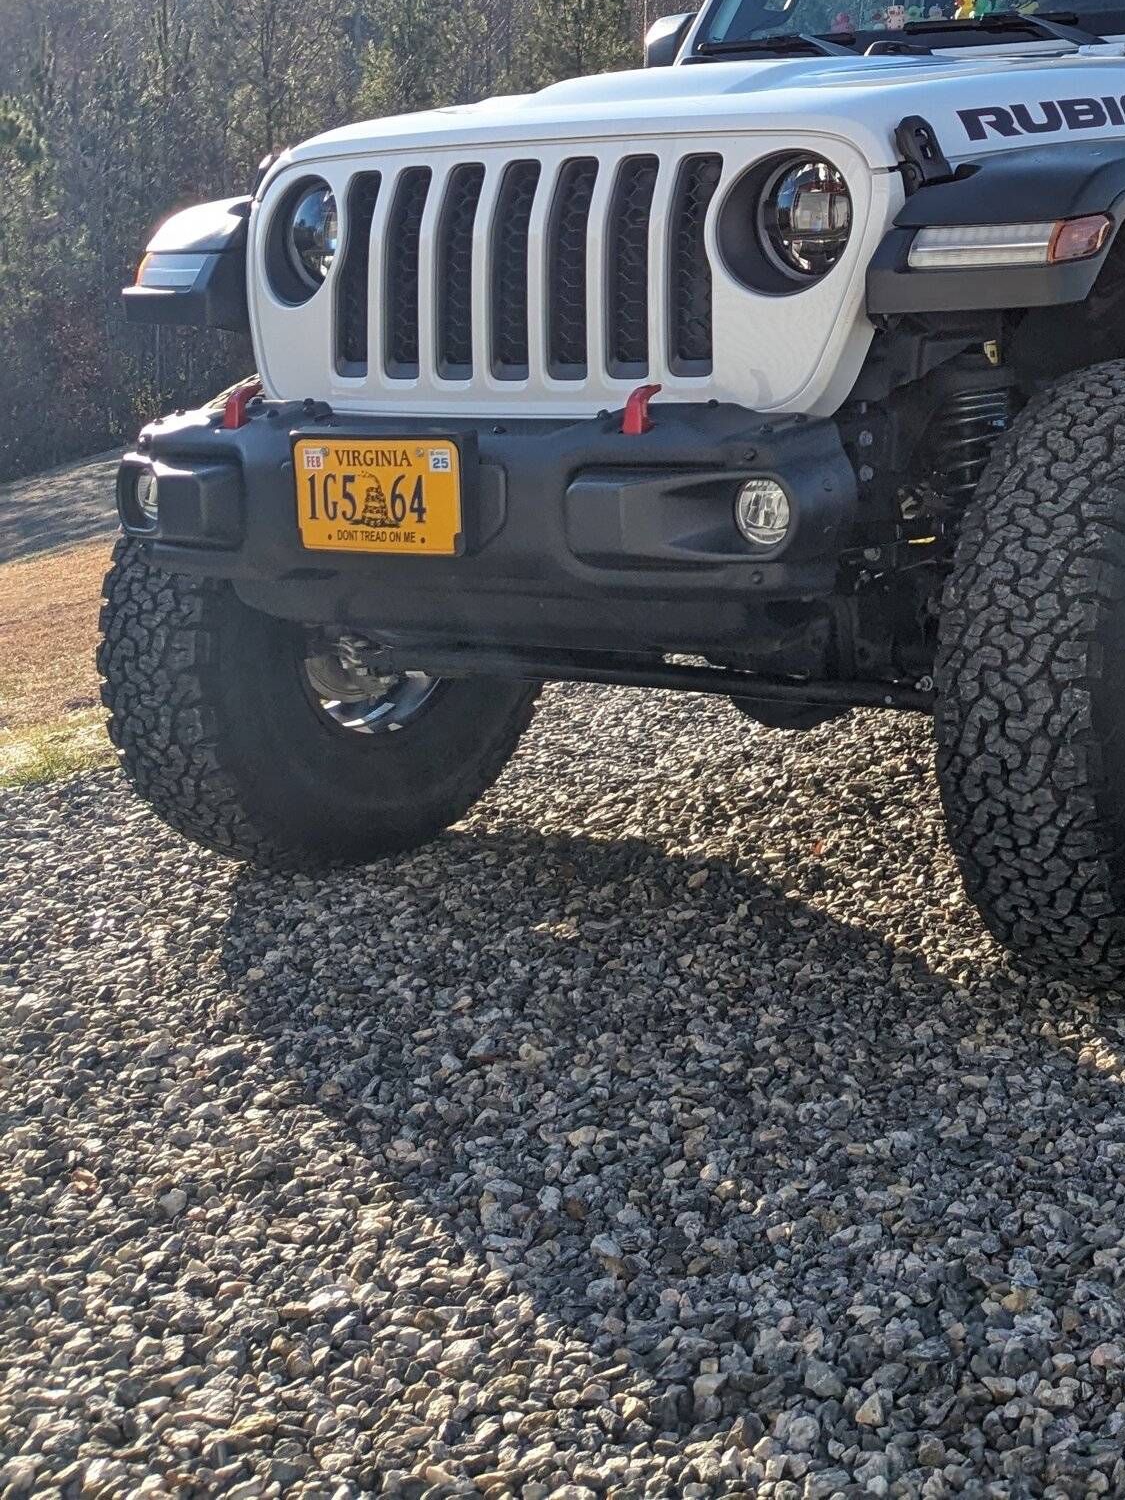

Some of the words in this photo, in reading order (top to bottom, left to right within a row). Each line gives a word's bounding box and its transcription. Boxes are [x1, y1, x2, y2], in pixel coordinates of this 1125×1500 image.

[306, 455, 321, 468] FEB
[335, 449, 413, 467] VIRGINIA
[432, 457, 449, 469] 25
[337, 529, 359, 541] DONT
[360, 530, 387, 542] TREAD
[389, 531, 401, 542] ON
[403, 531, 416, 543] ME
